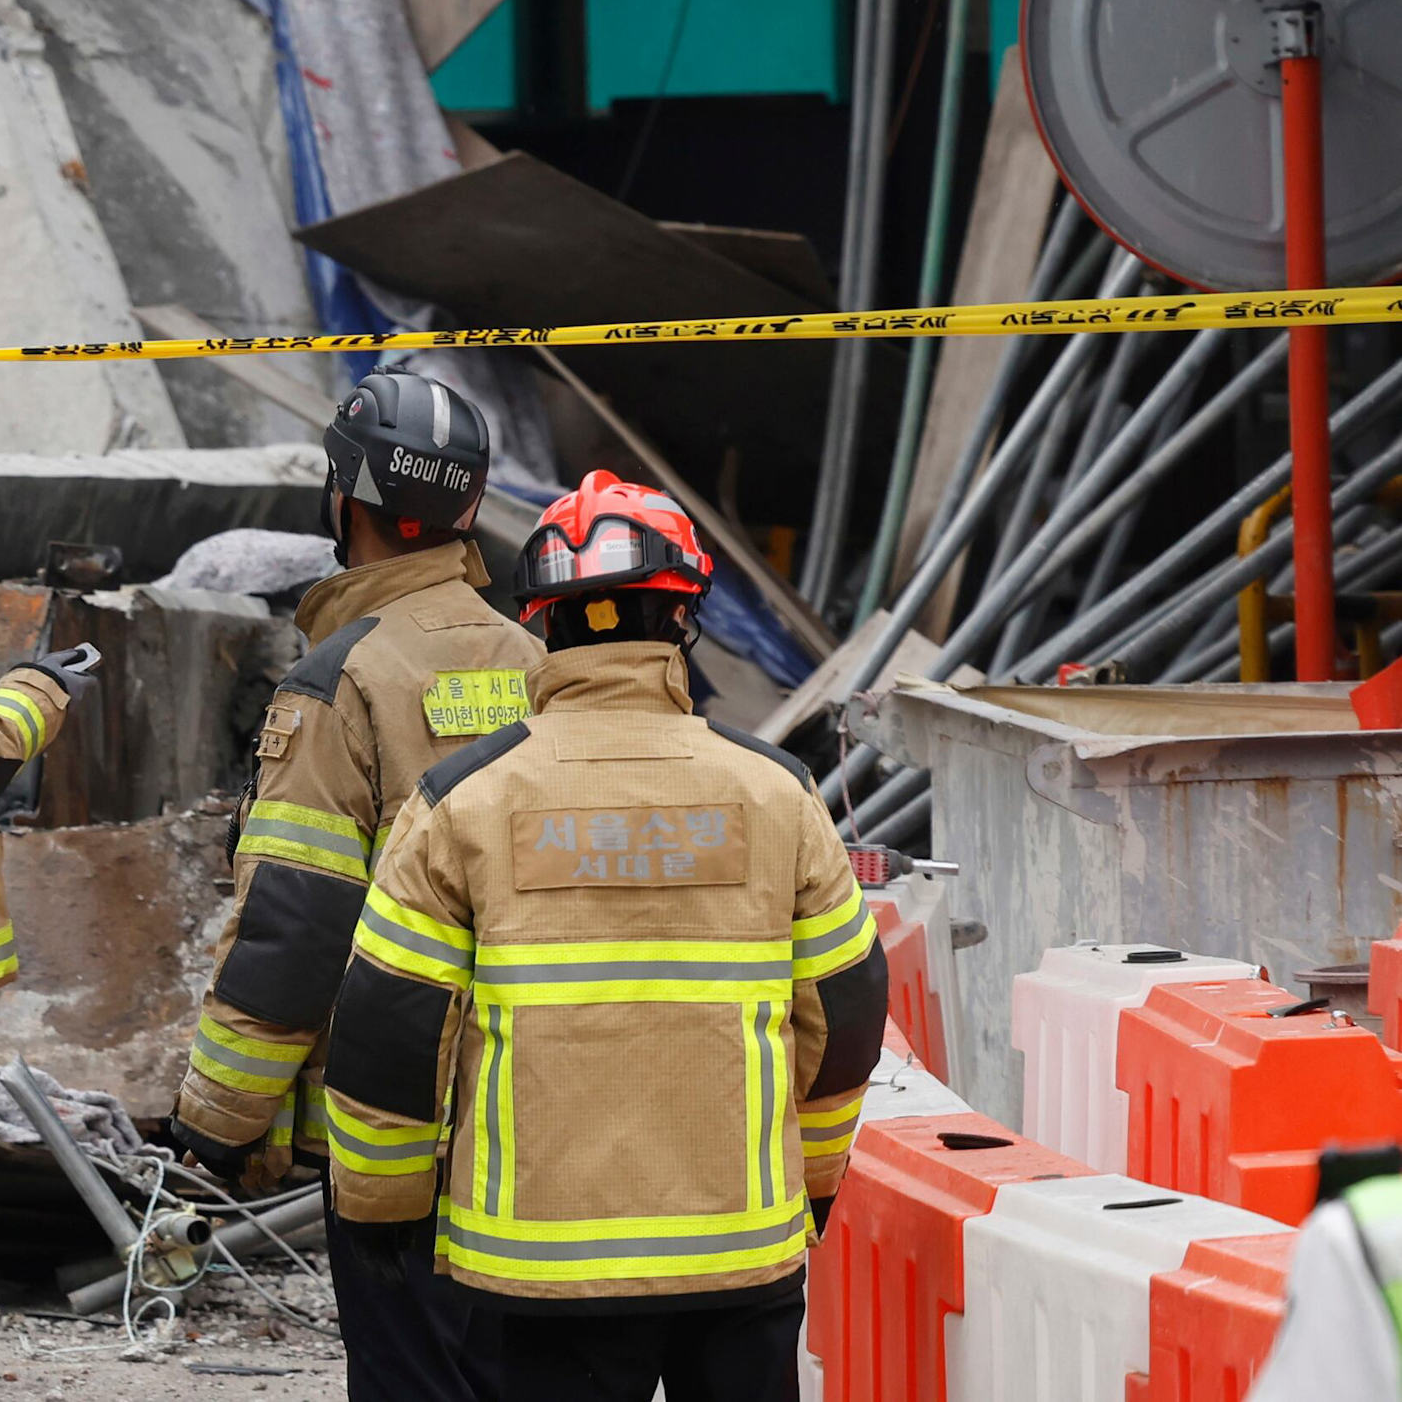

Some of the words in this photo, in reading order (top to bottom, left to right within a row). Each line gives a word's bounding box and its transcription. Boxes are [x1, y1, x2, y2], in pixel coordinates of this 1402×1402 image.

[389, 445, 442, 484] Seoul
[442, 461, 471, 492] fire
[533, 807, 728, 852] 서울소방
[571, 852, 695, 879] 서대문
